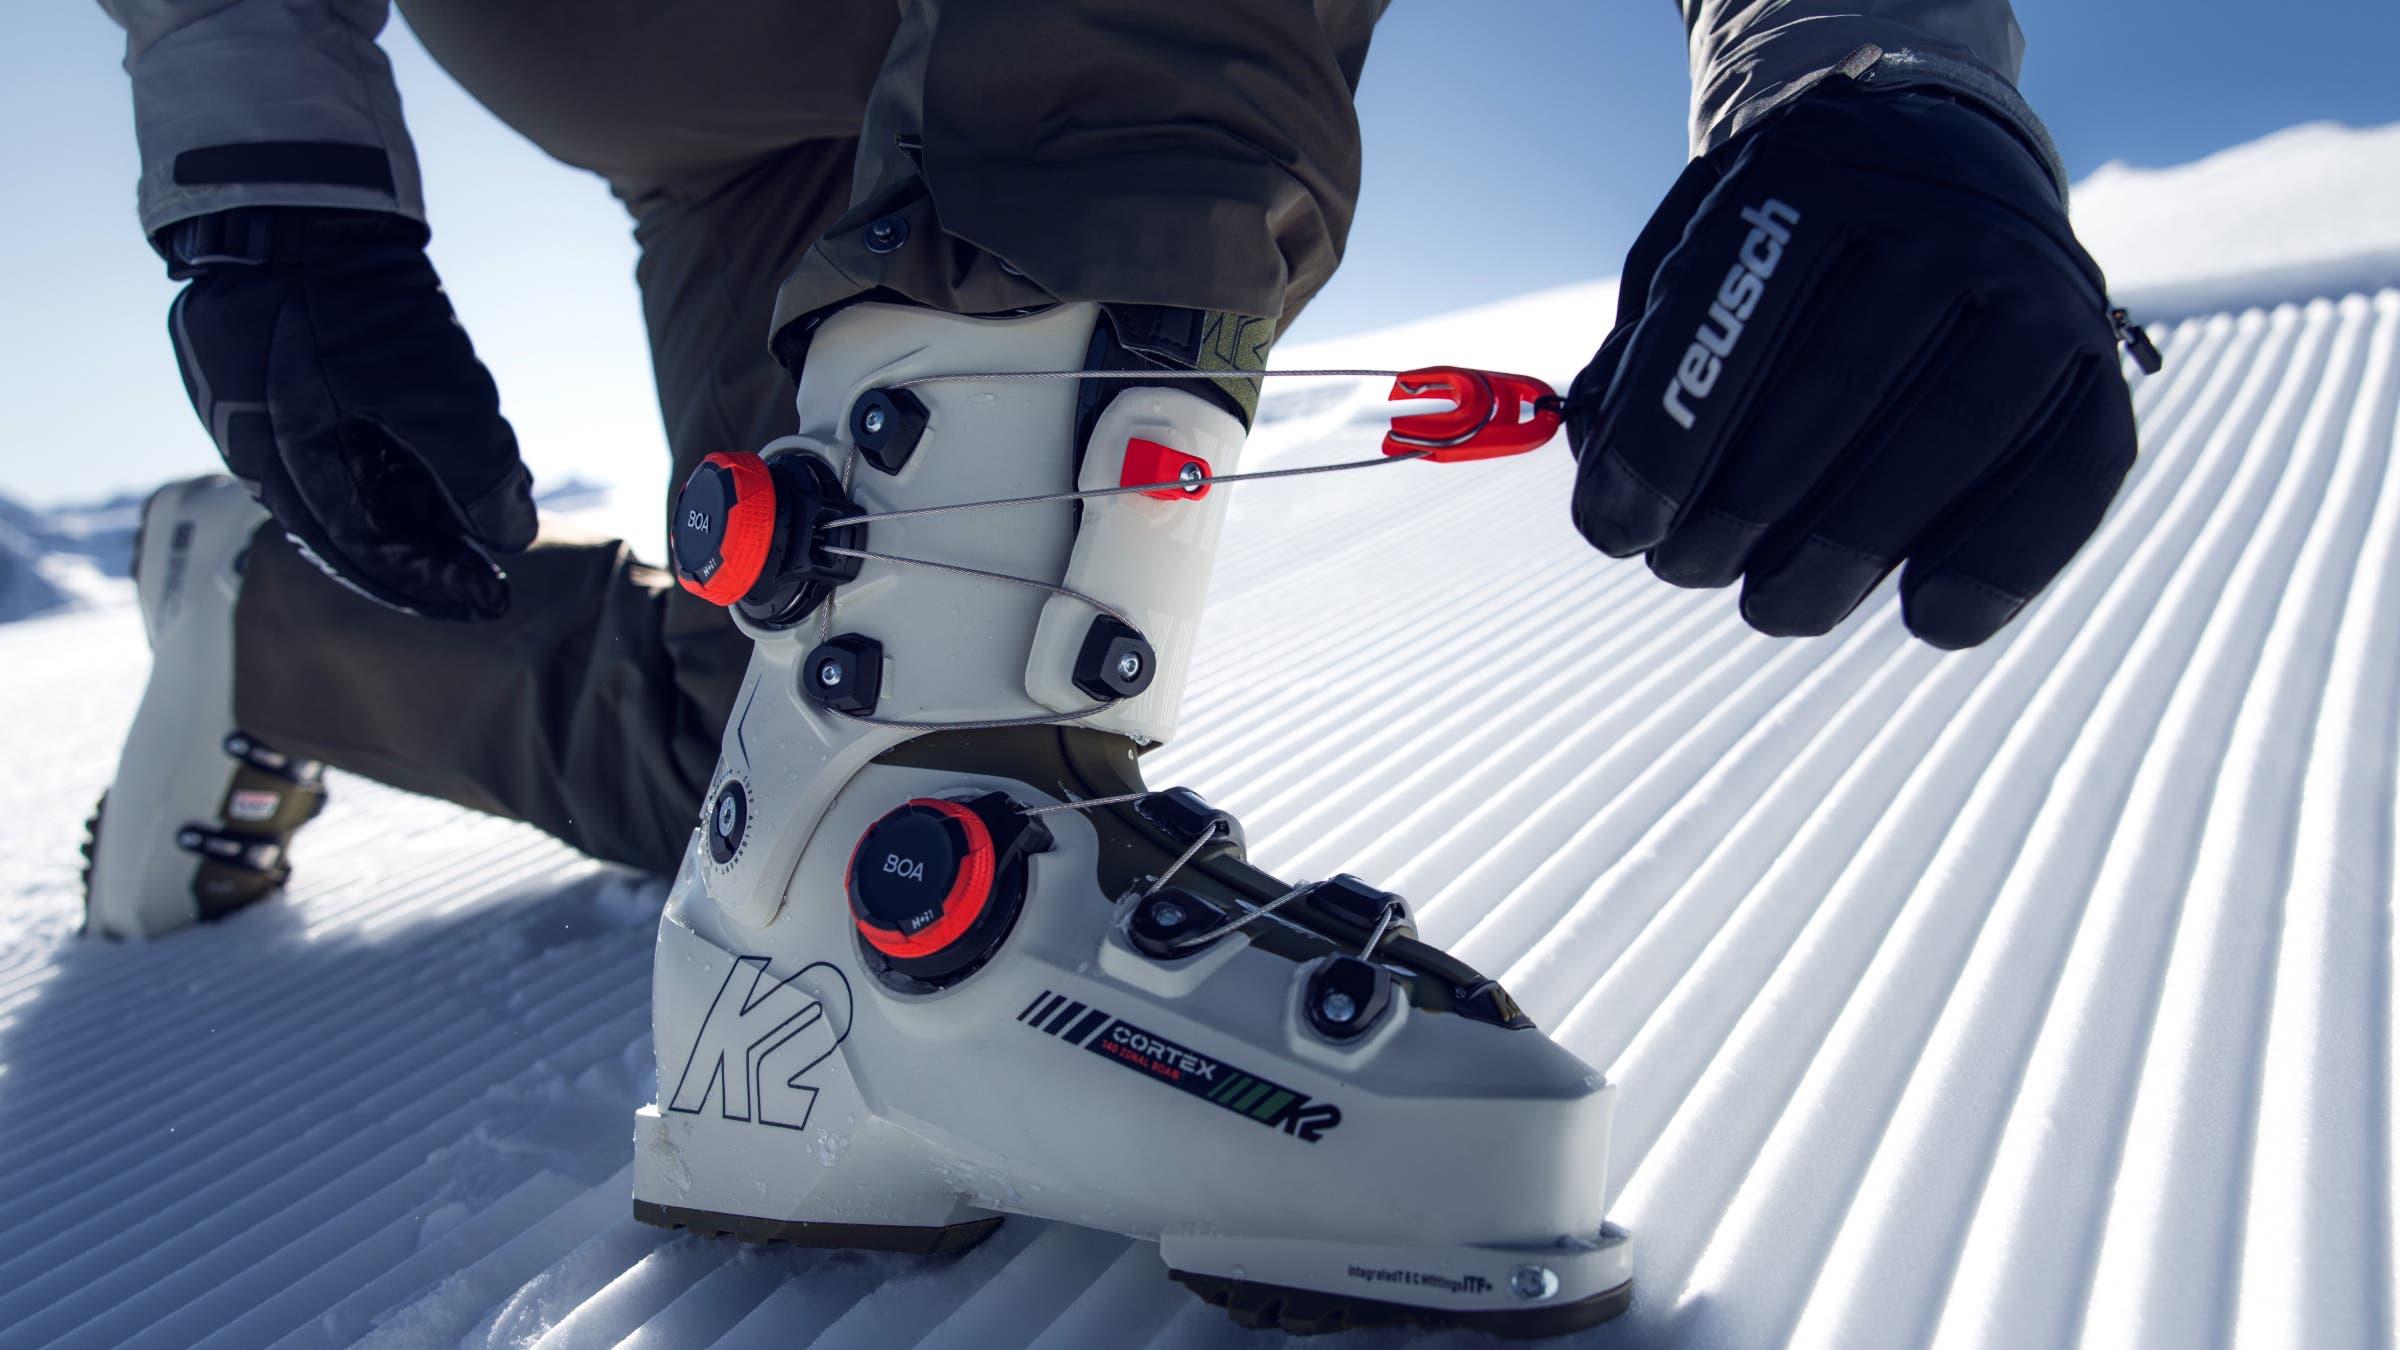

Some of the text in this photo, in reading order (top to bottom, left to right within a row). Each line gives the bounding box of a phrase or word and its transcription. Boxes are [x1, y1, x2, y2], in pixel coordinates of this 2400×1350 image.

[1662, 198, 1800, 430] reusch
[688, 510, 710, 533] BOA
[883, 854, 925, 882] BOA
[668, 955, 854, 1131] K2
[1112, 1025, 1218, 1081] CORTEX
[1282, 1097, 1342, 1143] K2
